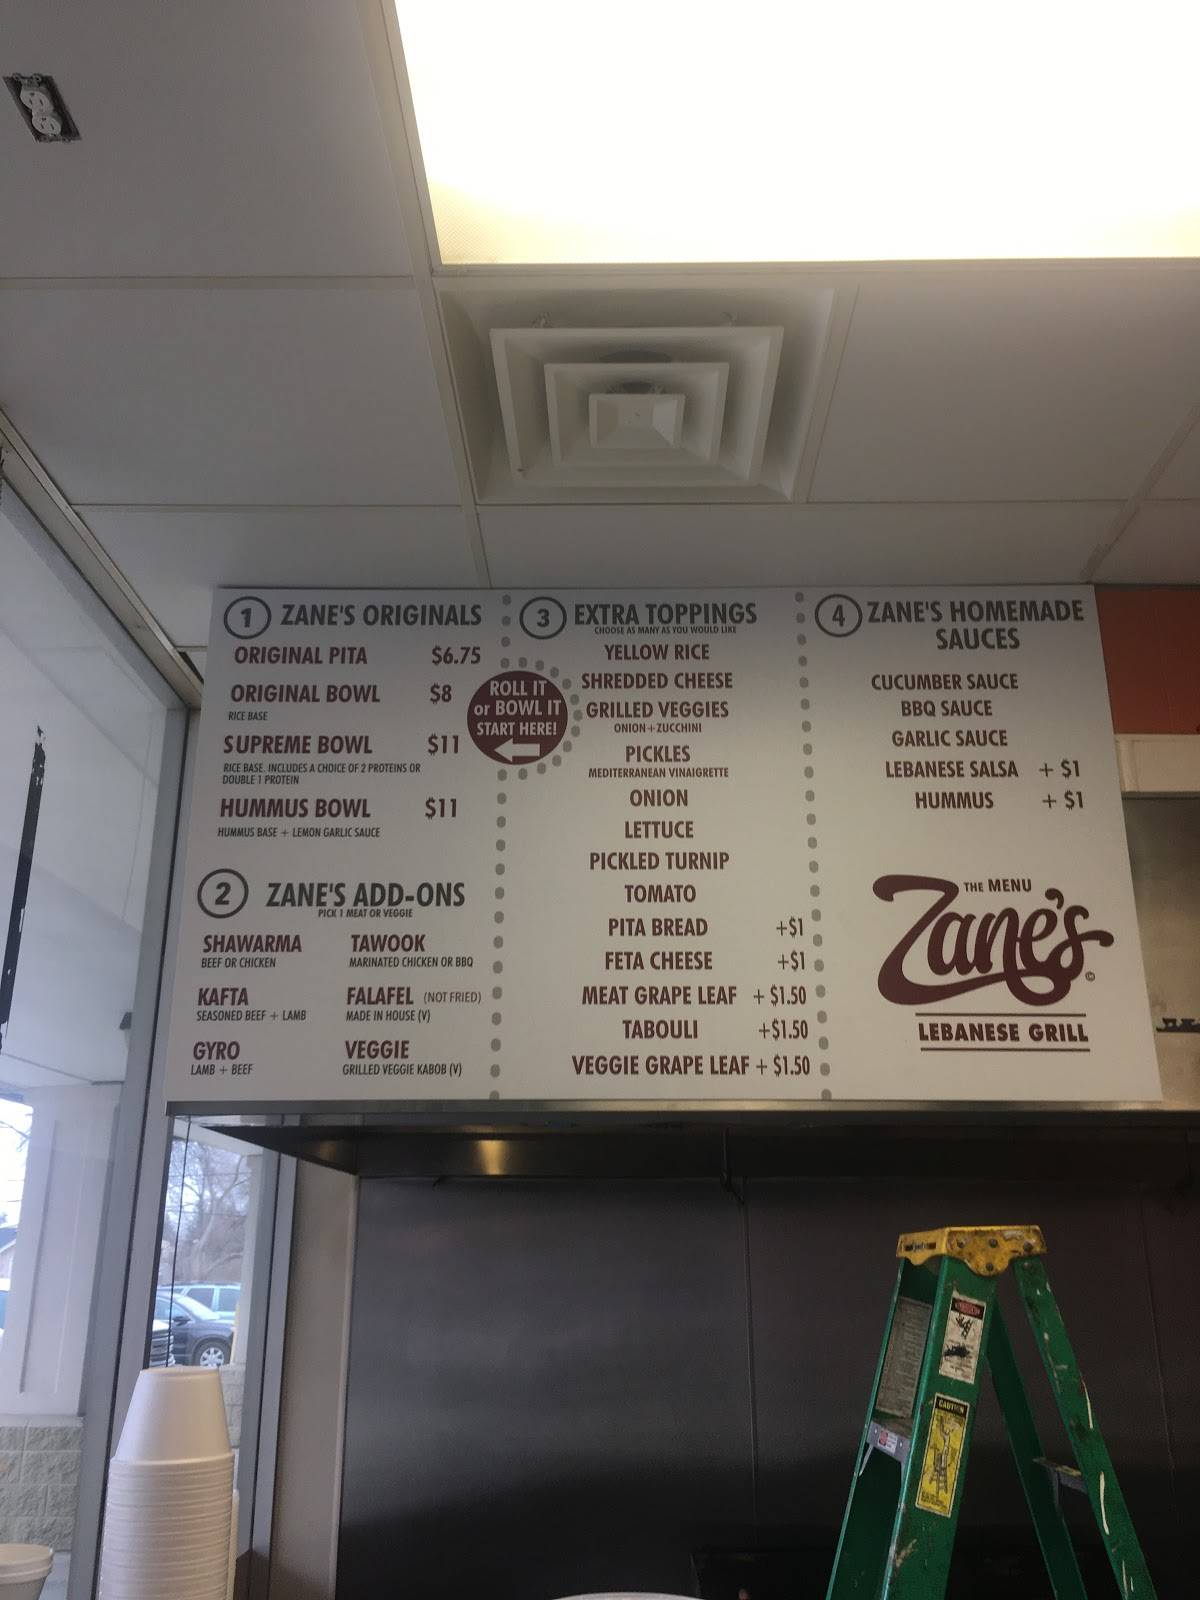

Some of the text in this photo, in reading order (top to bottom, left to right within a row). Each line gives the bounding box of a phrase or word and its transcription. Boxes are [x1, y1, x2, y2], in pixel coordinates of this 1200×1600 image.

[241, 608, 252, 628] 1
[280, 604, 482, 626] ZANE'S ORIGINALS
[536, 609, 550, 627] 3
[574, 603, 757, 625] EXTRA TOPPINGS
[832, 605, 845, 626] 4
[867, 600, 1084, 623] ZANE'S HOMEMADE
[594, 626, 624, 634] CHOOSE
[638, 626, 660, 634] MANY
[662, 626, 671, 634] AS
[672, 626, 688, 634] YOU
[690, 626, 718, 634] WOULD
[721, 626, 736, 634] LIKE
[936, 628, 1020, 650] SAUCES
[234, 645, 481, 666] ORIGINAL PITA $6.75
[605, 644, 710, 660] YELLOW RICE
[490, 680, 547, 697] ROLL IT
[581, 673, 733, 689] SHREDDED CHEESE
[871, 673, 1019, 690] CUCUMBER SAUCE
[231, 683, 452, 704] ORIGINAL BOWL $8
[228, 712, 268, 721] RICE BASE
[474, 700, 562, 716] or BOWL IT
[586, 701, 729, 718] GRILLED VEGGIES
[901, 700, 992, 717] BBQ SAUCE
[476, 722, 557, 736] START HERE!
[892, 730, 1008, 746] GARLIC SAUCE
[224, 734, 459, 756] SUPREME BOWL $11
[625, 745, 691, 763] PICKLES
[223, 764, 240, 773] RICE
[268, 763, 307, 773] INCLUDES
[317, 763, 346, 773] CHOICE
[348, 763, 358, 773] OF
[360, 763, 366, 773] 2
[368, 763, 405, 773] PROTEINS
[407, 763, 421, 773] OR
[588, 768, 729, 778] MEDITERRANEAN VINAIGRETTE
[886, 761, 964, 778] LEBANESE
[970, 761, 1019, 777] SALSA
[1061, 759, 1080, 779] $1
[223, 775, 255, 785] DOUBLE
[266, 775, 299, 784] PROTEIN
[630, 790, 688, 807] ONION
[915, 792, 993, 809] HUMMUS
[1065, 790, 1084, 810] $1
[220, 797, 457, 819] HUMMUS BOWL $11
[218, 828, 254, 837] HUMMUS
[257, 828, 277, 837] BASE
[292, 827, 321, 837] LEMON
[323, 827, 352, 837] GARLIC
[354, 827, 380, 837] SAUCE
[625, 821, 693, 838] LETTUCE
[590, 852, 729, 870] PICKLED TURNIP
[214, 882, 231, 905] 2
[266, 882, 465, 907] ZANE'S ADD-ONS
[625, 885, 696, 902] TOMATO
[964, 879, 1032, 892] THE MENU
[318, 909, 337, 917] PICK
[346, 909, 367, 917] MEAT
[369, 909, 381, 917] OR
[383, 909, 413, 917] VEGGIE
[608, 918, 646, 936] PITA
[652, 918, 708, 936] BREAD
[203, 935, 302, 953] SHAWARMA
[351, 934, 426, 952] TAWOOK
[872, 874, 1114, 1006] Zane's
[201, 957, 276, 968] BEEF OR CHICKEN
[349, 957, 473, 968] MARINATED CHICKEN OR BBQ
[605, 952, 644, 970] FETA
[650, 951, 712, 970] CHEESE
[198, 988, 249, 1006] KAFTA
[347, 987, 482, 1005] FALAFEL (NOT FRIED)
[582, 986, 628, 1005] MEAT
[634, 986, 691, 1005] GRAPE
[698, 986, 737, 1005] LEAF
[770, 984, 806, 1006] $1.50
[197, 1011, 243, 1022] SEASONED
[245, 1010, 267, 1021] BEEF
[282, 1010, 306, 1021] LAMB
[346, 1010, 431, 1023] MADE IN HOUSE (V)
[623, 1020, 698, 1039] TABOULI
[918, 1023, 1088, 1042] LEBANESE GRILL
[193, 1041, 240, 1060] GYRO
[345, 1041, 409, 1059] VEGGIE
[191, 1064, 216, 1075] LAMB
[231, 1064, 253, 1074] BEEF
[343, 1064, 462, 1077] GRILLED VEGGIE KABOB (V)
[572, 1056, 639, 1075] VEGGIE
[646, 1056, 703, 1075] GRAPE
[710, 1056, 750, 1075] LEAF
[773, 1054, 810, 1077] $1.50
